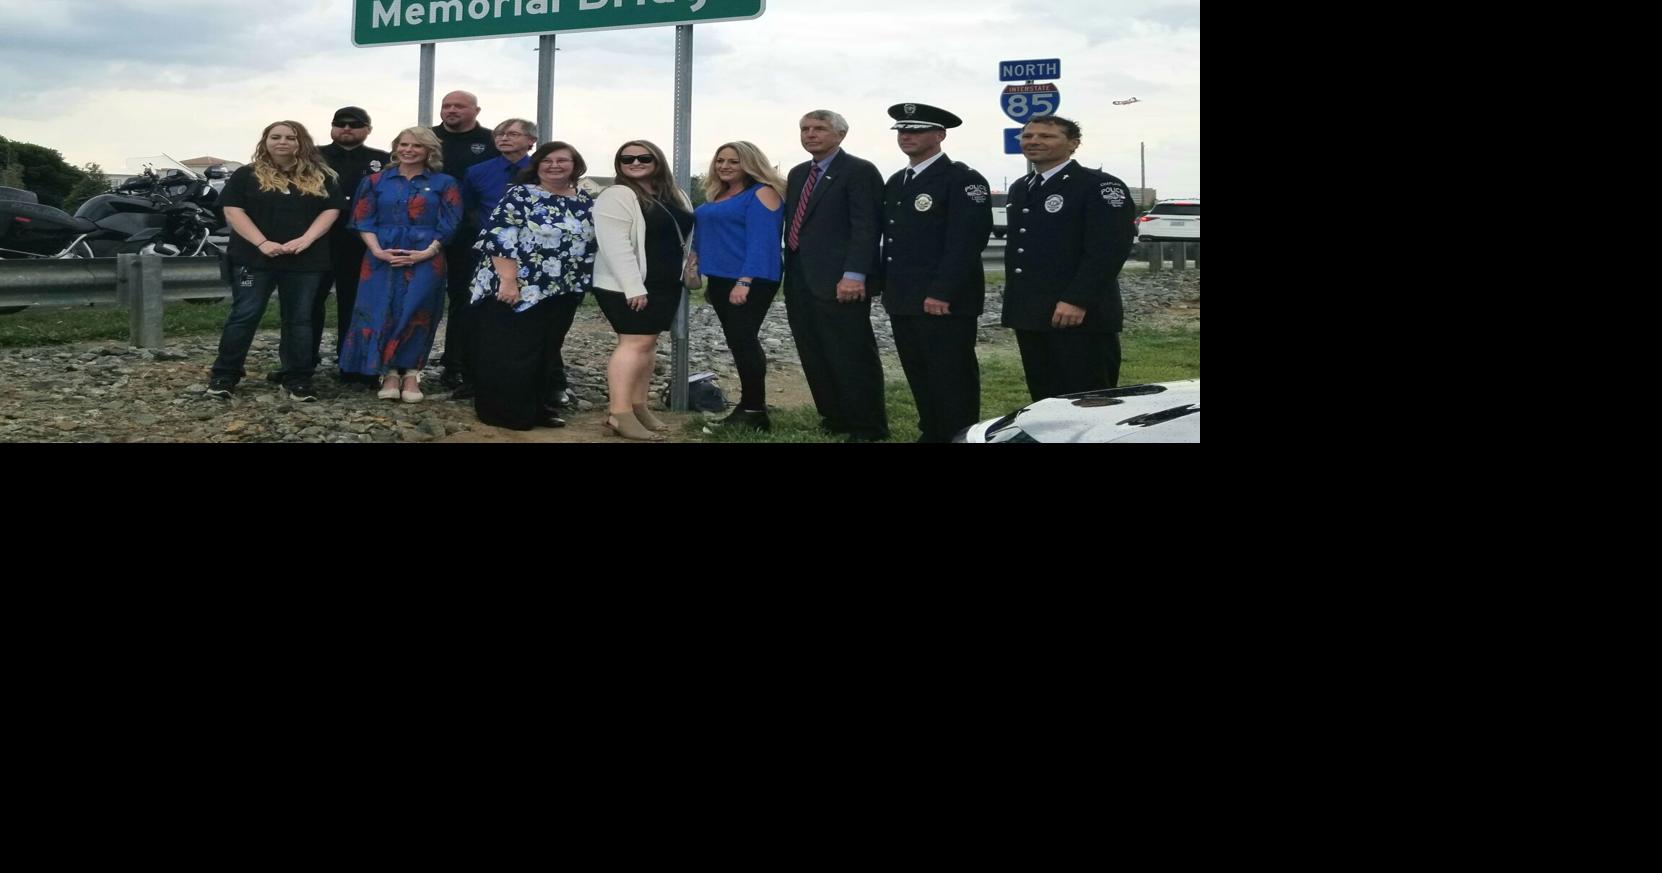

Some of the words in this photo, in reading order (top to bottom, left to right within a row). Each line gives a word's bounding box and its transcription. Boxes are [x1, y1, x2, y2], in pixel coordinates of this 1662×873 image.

[1003, 63, 1056, 77] NORTH
[1007, 94, 1053, 117] 85
[1101, 186, 1124, 195] POLICE
